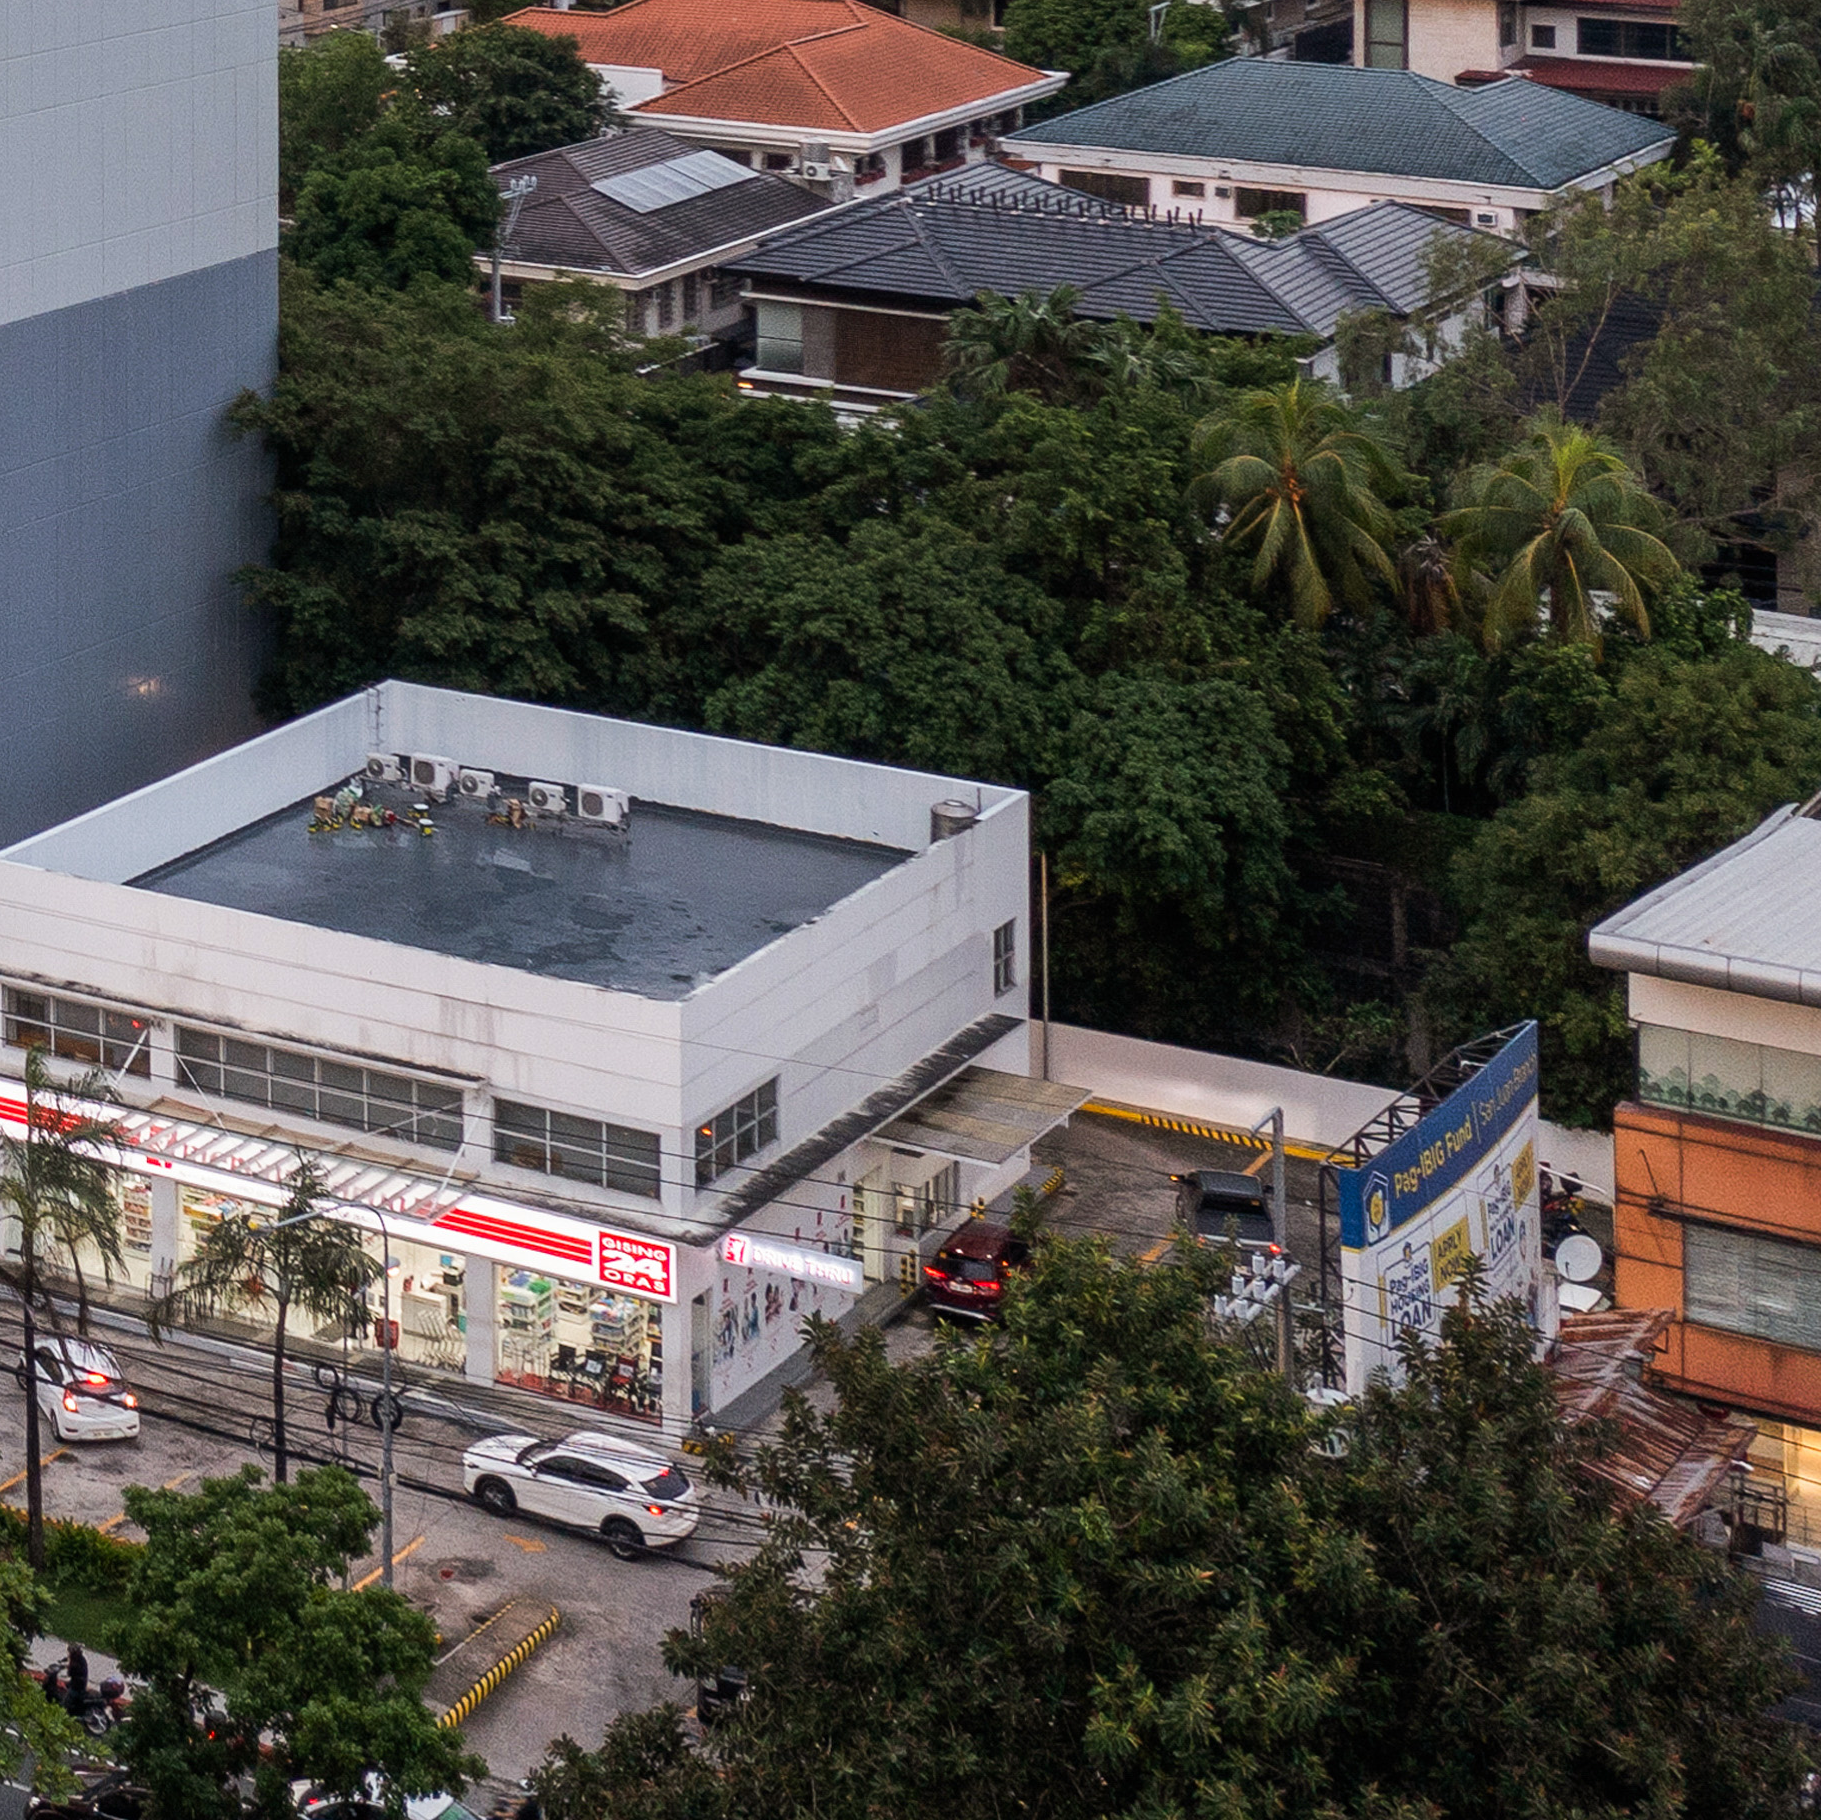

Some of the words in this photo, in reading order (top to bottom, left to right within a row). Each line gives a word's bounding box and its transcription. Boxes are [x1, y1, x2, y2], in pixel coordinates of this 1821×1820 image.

[1394, 1139, 1445, 1199] Pag-IBIG
[1445, 1113, 1473, 1159] Fund
[601, 1236, 668, 1262] GISING
[752, 1247, 805, 1275] DRIVE
[601, 1249, 668, 1281] 24
[603, 1268, 667, 1293] ORAS
[1391, 1295, 1432, 1342] LOAN
